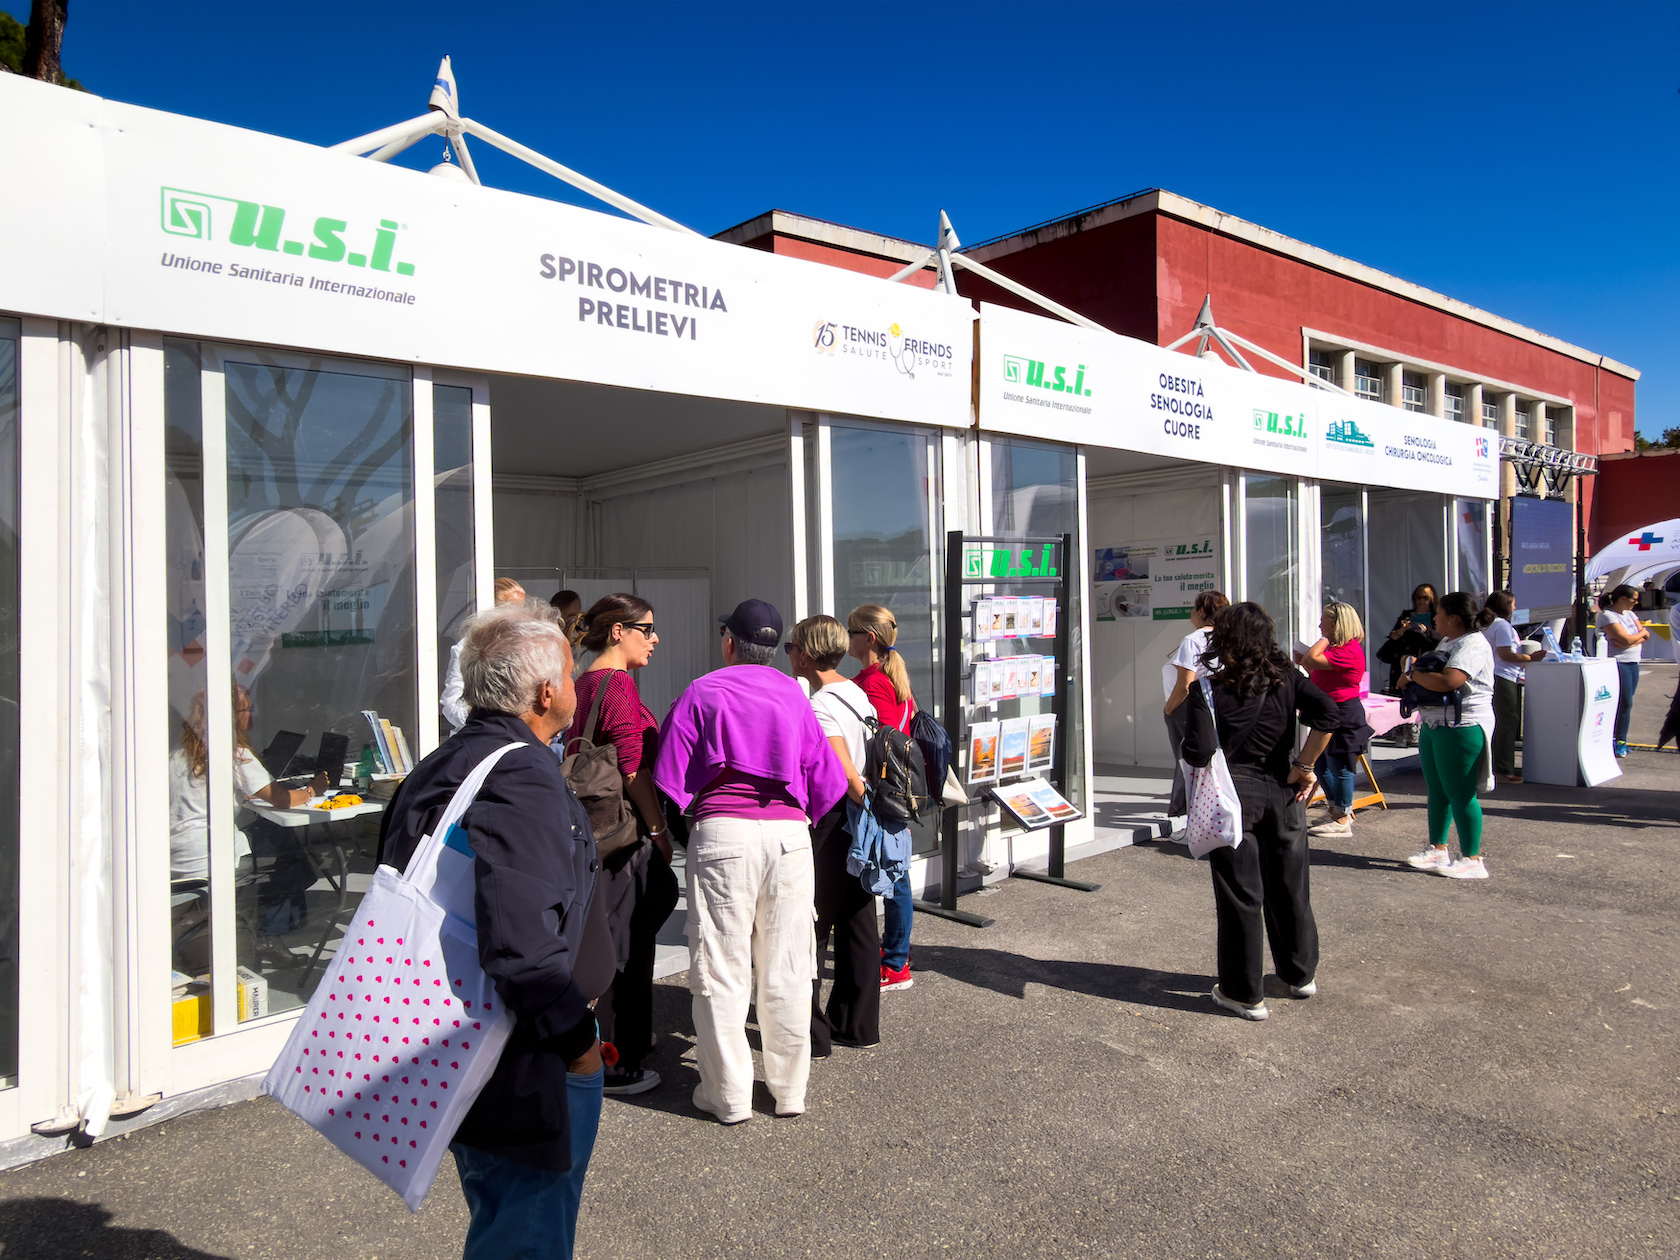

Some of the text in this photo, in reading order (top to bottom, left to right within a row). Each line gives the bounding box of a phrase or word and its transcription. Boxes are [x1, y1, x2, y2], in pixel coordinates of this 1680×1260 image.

[229, 201, 416, 277] u.s.i.
[160, 252, 416, 306] Unione Sanitaria Internazionale
[539, 252, 728, 313] SPIROMETRIA
[578, 296, 697, 341] PRELIEVI
[842, 325, 953, 359] TENNIS FRIENDS
[842, 343, 953, 370] SALUTE SPORT
[1026, 359, 1092, 397] u.s.i.
[1158, 372, 1205, 398] OBESITÀ
[1003, 391, 1092, 415] Unione Sanitaria Internazionale
[1150, 393, 1214, 421] SENOLOGIA
[1164, 418, 1201, 440] CUORE
[1266, 412, 1308, 439] u.s.i.
[1384, 445, 1453, 466] CHIRURGIA ONCOLOGICA
[1404, 435, 1437, 450] SENOLOGIA
[1174, 573, 1193, 581] salute
[1193, 572, 1215, 580] merita
[1180, 581, 1215, 592] il meglio
[333, 598, 370, 612] meglio
[252, 986, 260, 1017] MAURER
